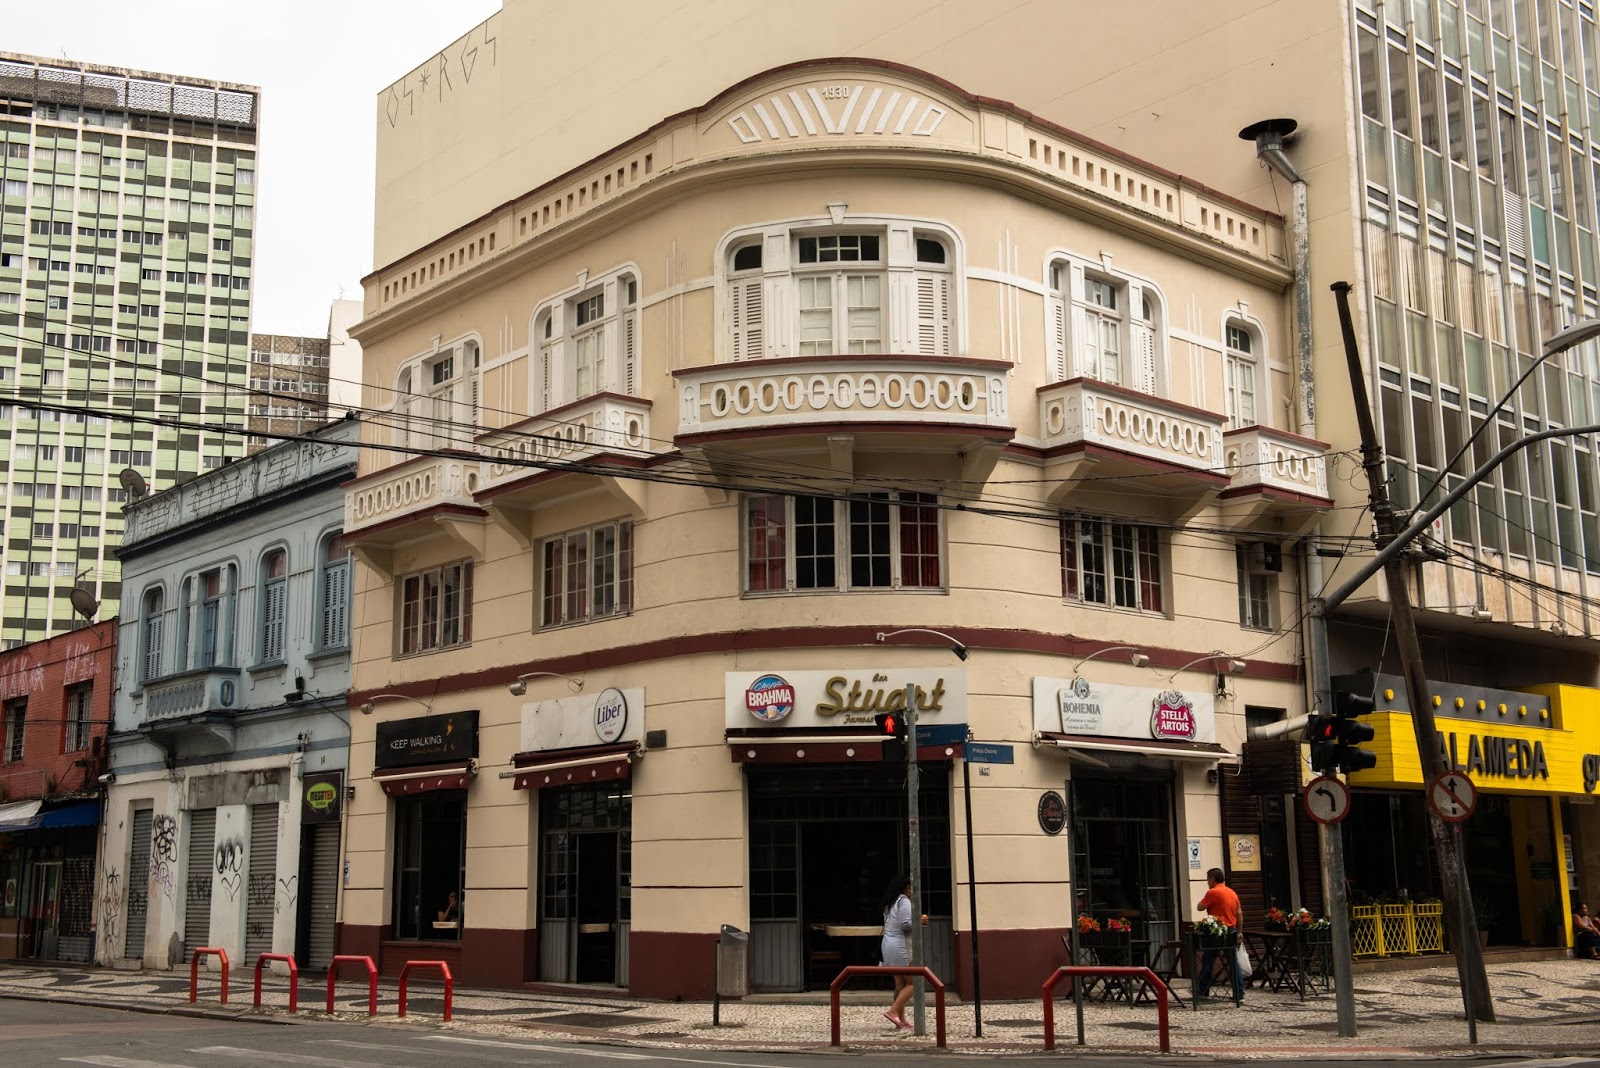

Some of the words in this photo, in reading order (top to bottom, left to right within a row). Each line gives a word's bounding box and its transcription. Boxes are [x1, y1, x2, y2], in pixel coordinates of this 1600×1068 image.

[822, 85, 849, 99] 1930
[748, 688, 793, 707] BRAHMA
[815, 676, 946, 717] Stuart
[597, 703, 622, 725] Liber
[1063, 701, 1101, 715] BOHEMIA
[1161, 709, 1189, 721] STELLA
[1161, 720, 1190, 732] ARTOIS
[390, 739, 408, 750] KEEP
[409, 735, 442, 748] WALKING
[1436, 730, 1550, 780] ALAMEDA
